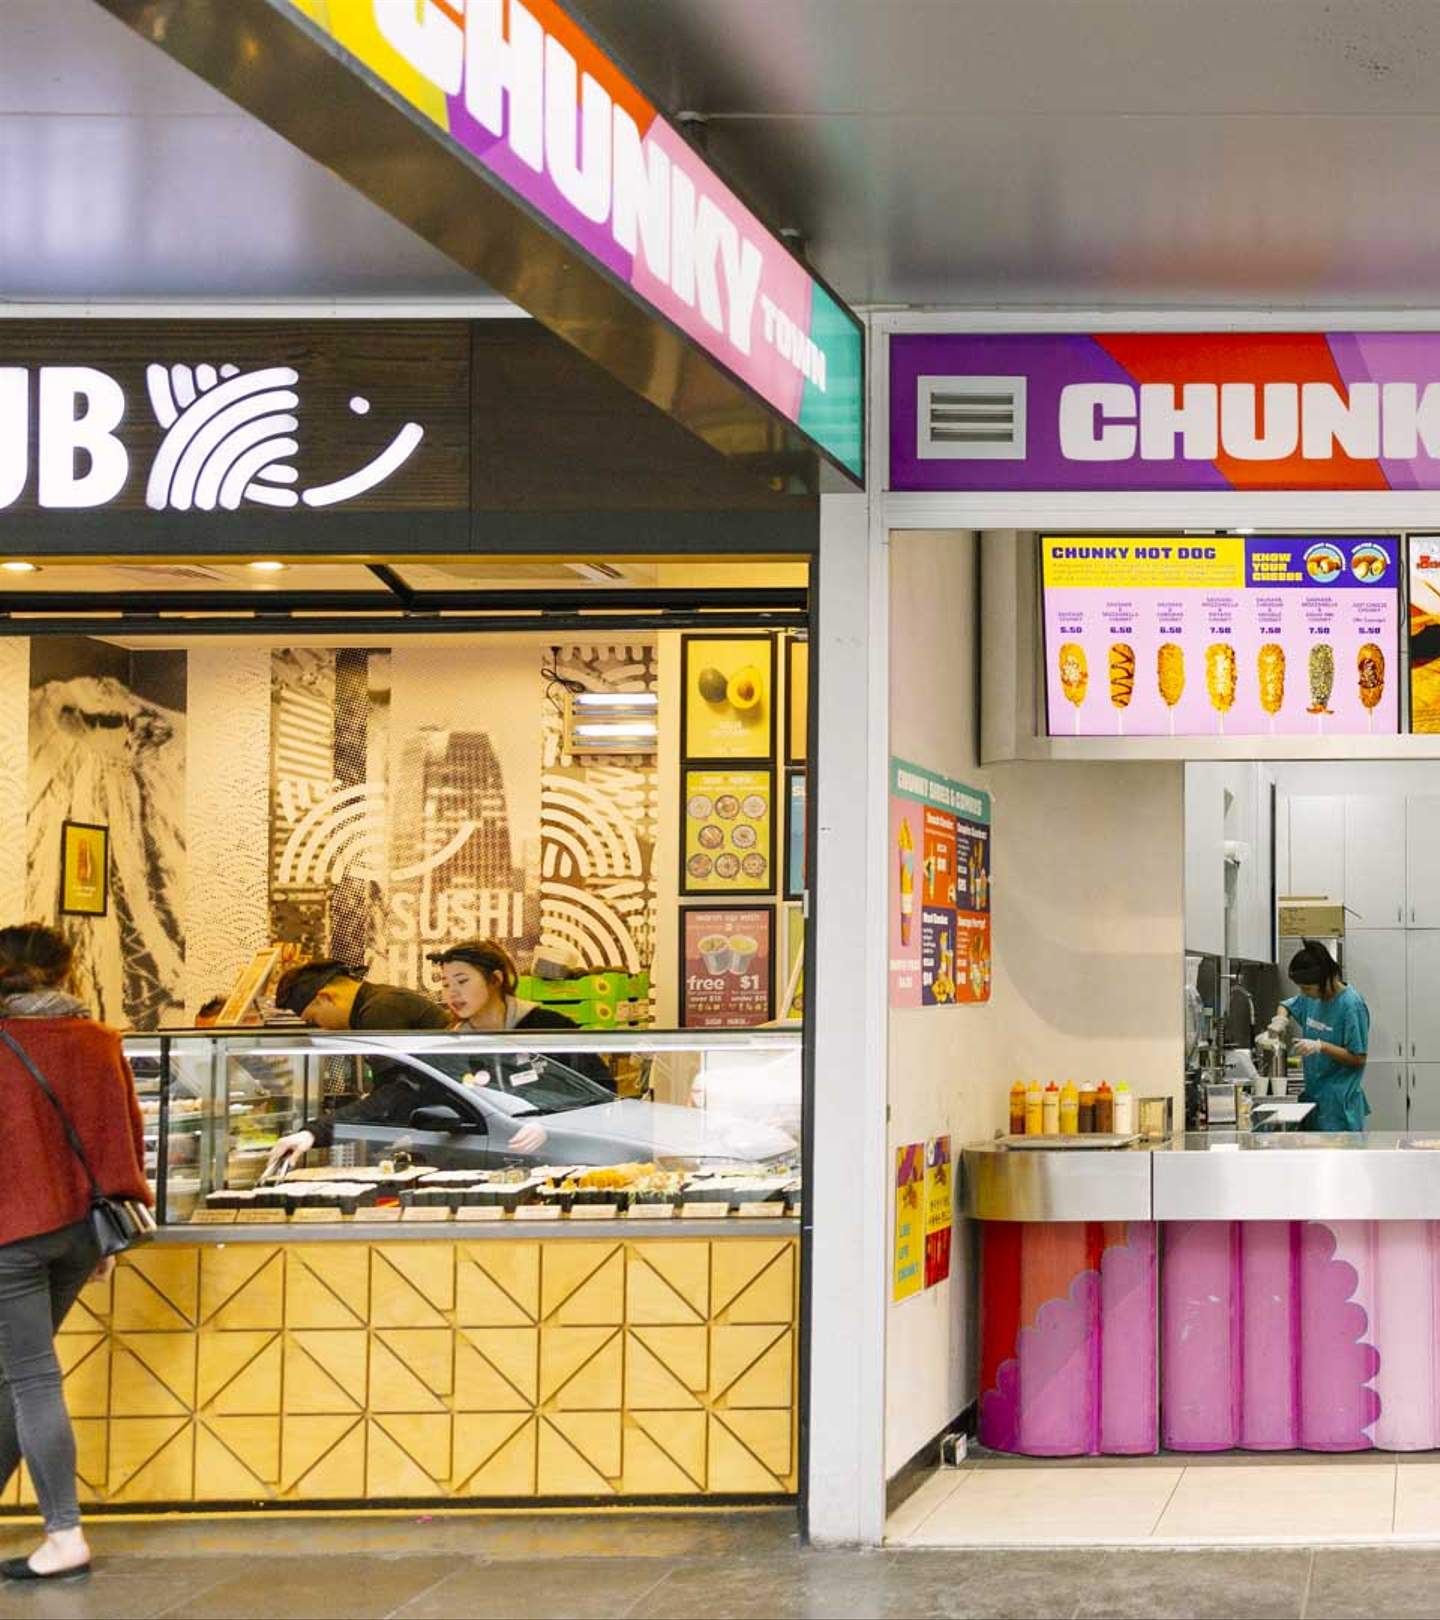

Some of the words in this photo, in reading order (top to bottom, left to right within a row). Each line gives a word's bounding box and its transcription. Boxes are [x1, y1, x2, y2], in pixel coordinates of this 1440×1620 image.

[761, 293, 827, 394] TOWN
[1052, 547, 1129, 559] CHUNKY
[1135, 547, 1173, 559] HOT
[1178, 547, 1216, 559] DOG
[1060, 626, 1083, 634] 5.50
[1210, 626, 1232, 634] 7.50
[1260, 626, 1282, 634] 7.50
[1309, 626, 1331, 634] 7.50
[390, 882, 524, 940] SUSHI
[686, 975, 725, 990] free
[740, 974, 760, 990] $1
